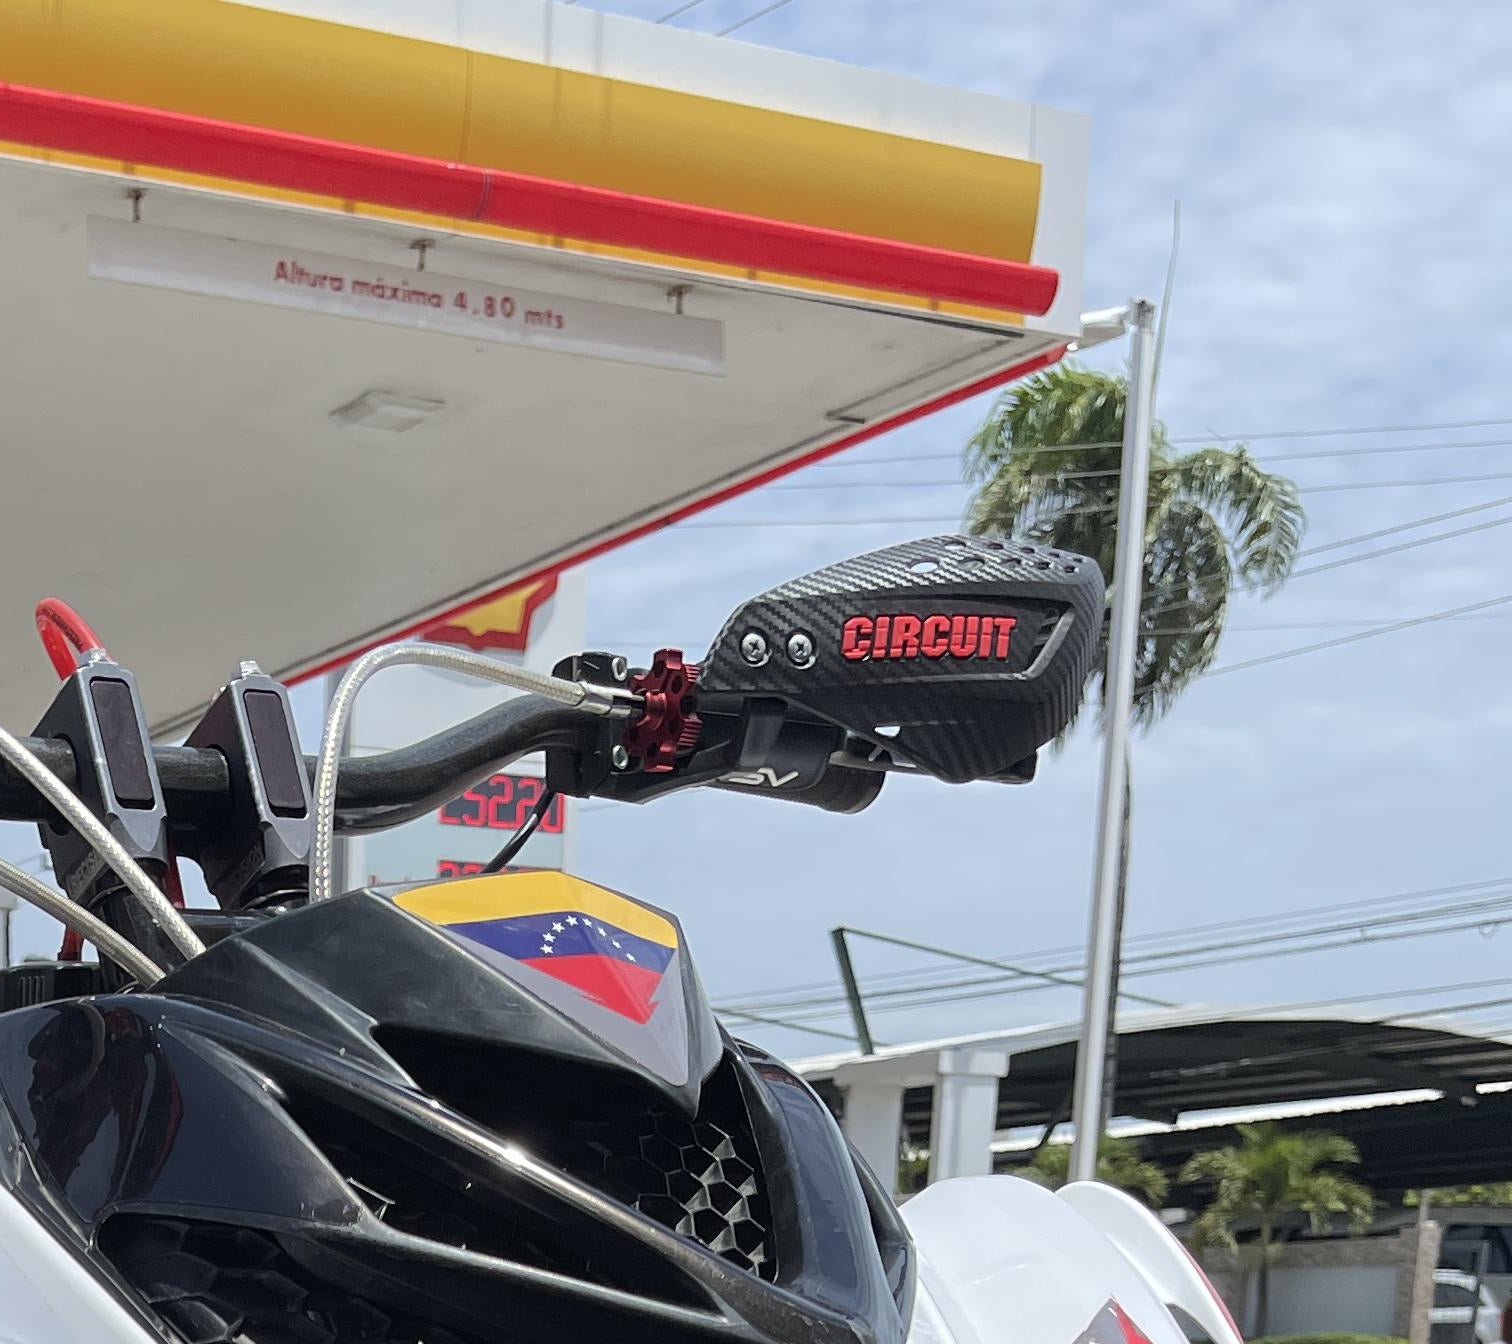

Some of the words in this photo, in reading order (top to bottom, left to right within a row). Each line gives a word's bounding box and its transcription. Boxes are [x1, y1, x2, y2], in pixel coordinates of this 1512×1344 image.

[273, 259, 343, 292] Altura
[352, 276, 443, 308] máxima
[453, 290, 515, 319] 4.80
[524, 308, 564, 330] mts
[841, 614, 1018, 661] CIRCUIT
